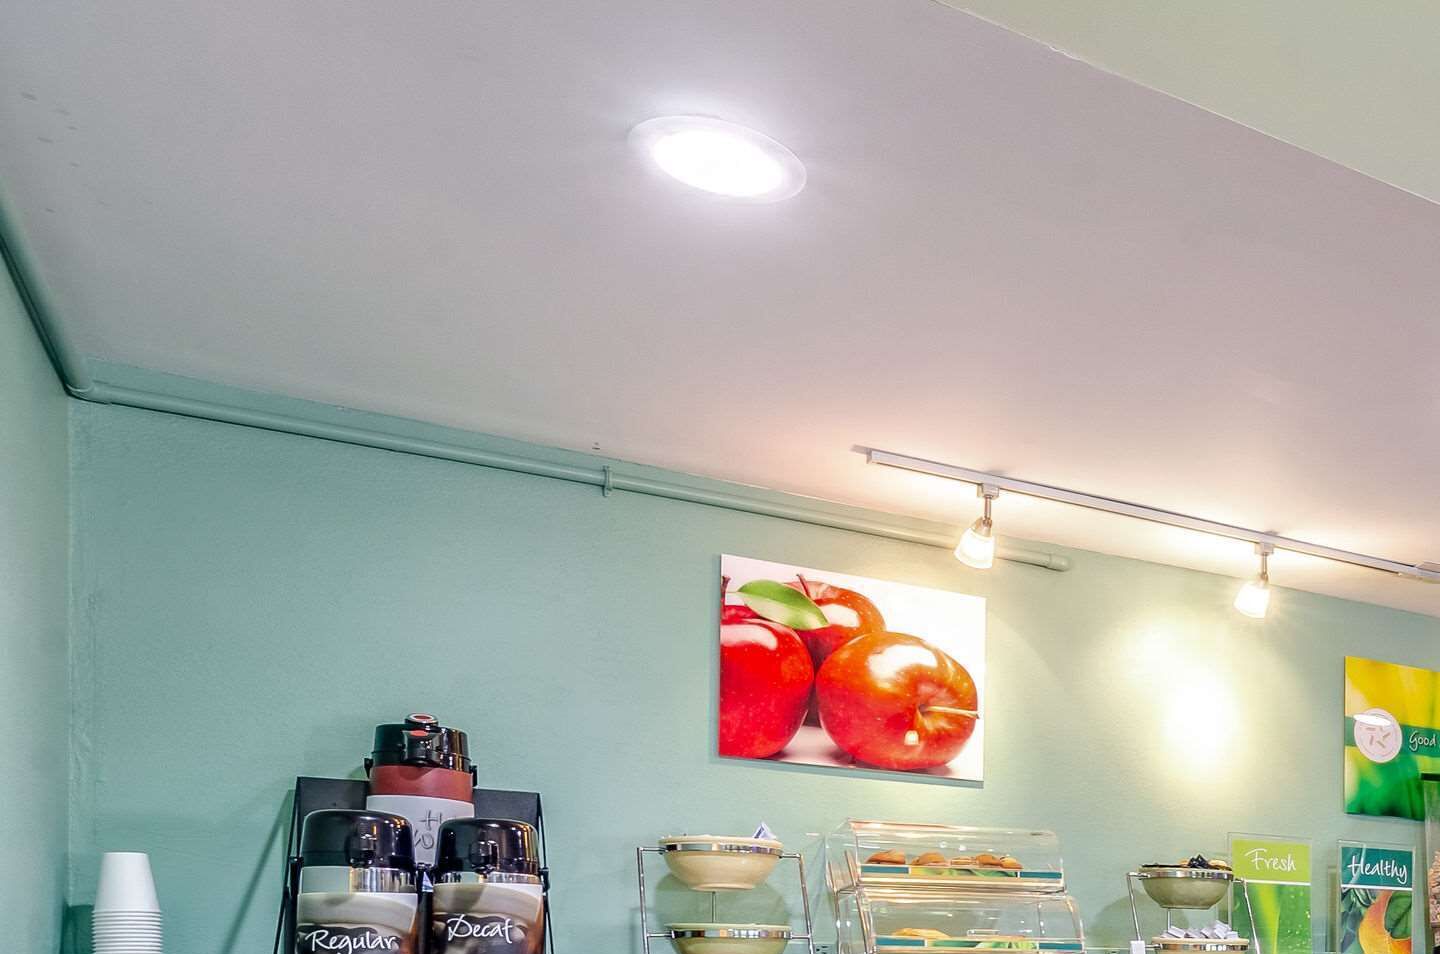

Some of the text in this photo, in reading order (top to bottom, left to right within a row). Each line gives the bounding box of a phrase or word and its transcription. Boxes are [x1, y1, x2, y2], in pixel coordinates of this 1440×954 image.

[1409, 731, 1437, 751] Good
[1244, 848, 1297, 872] Fresh
[1347, 855, 1408, 884] Healthy
[446, 914, 513, 943] Decaf
